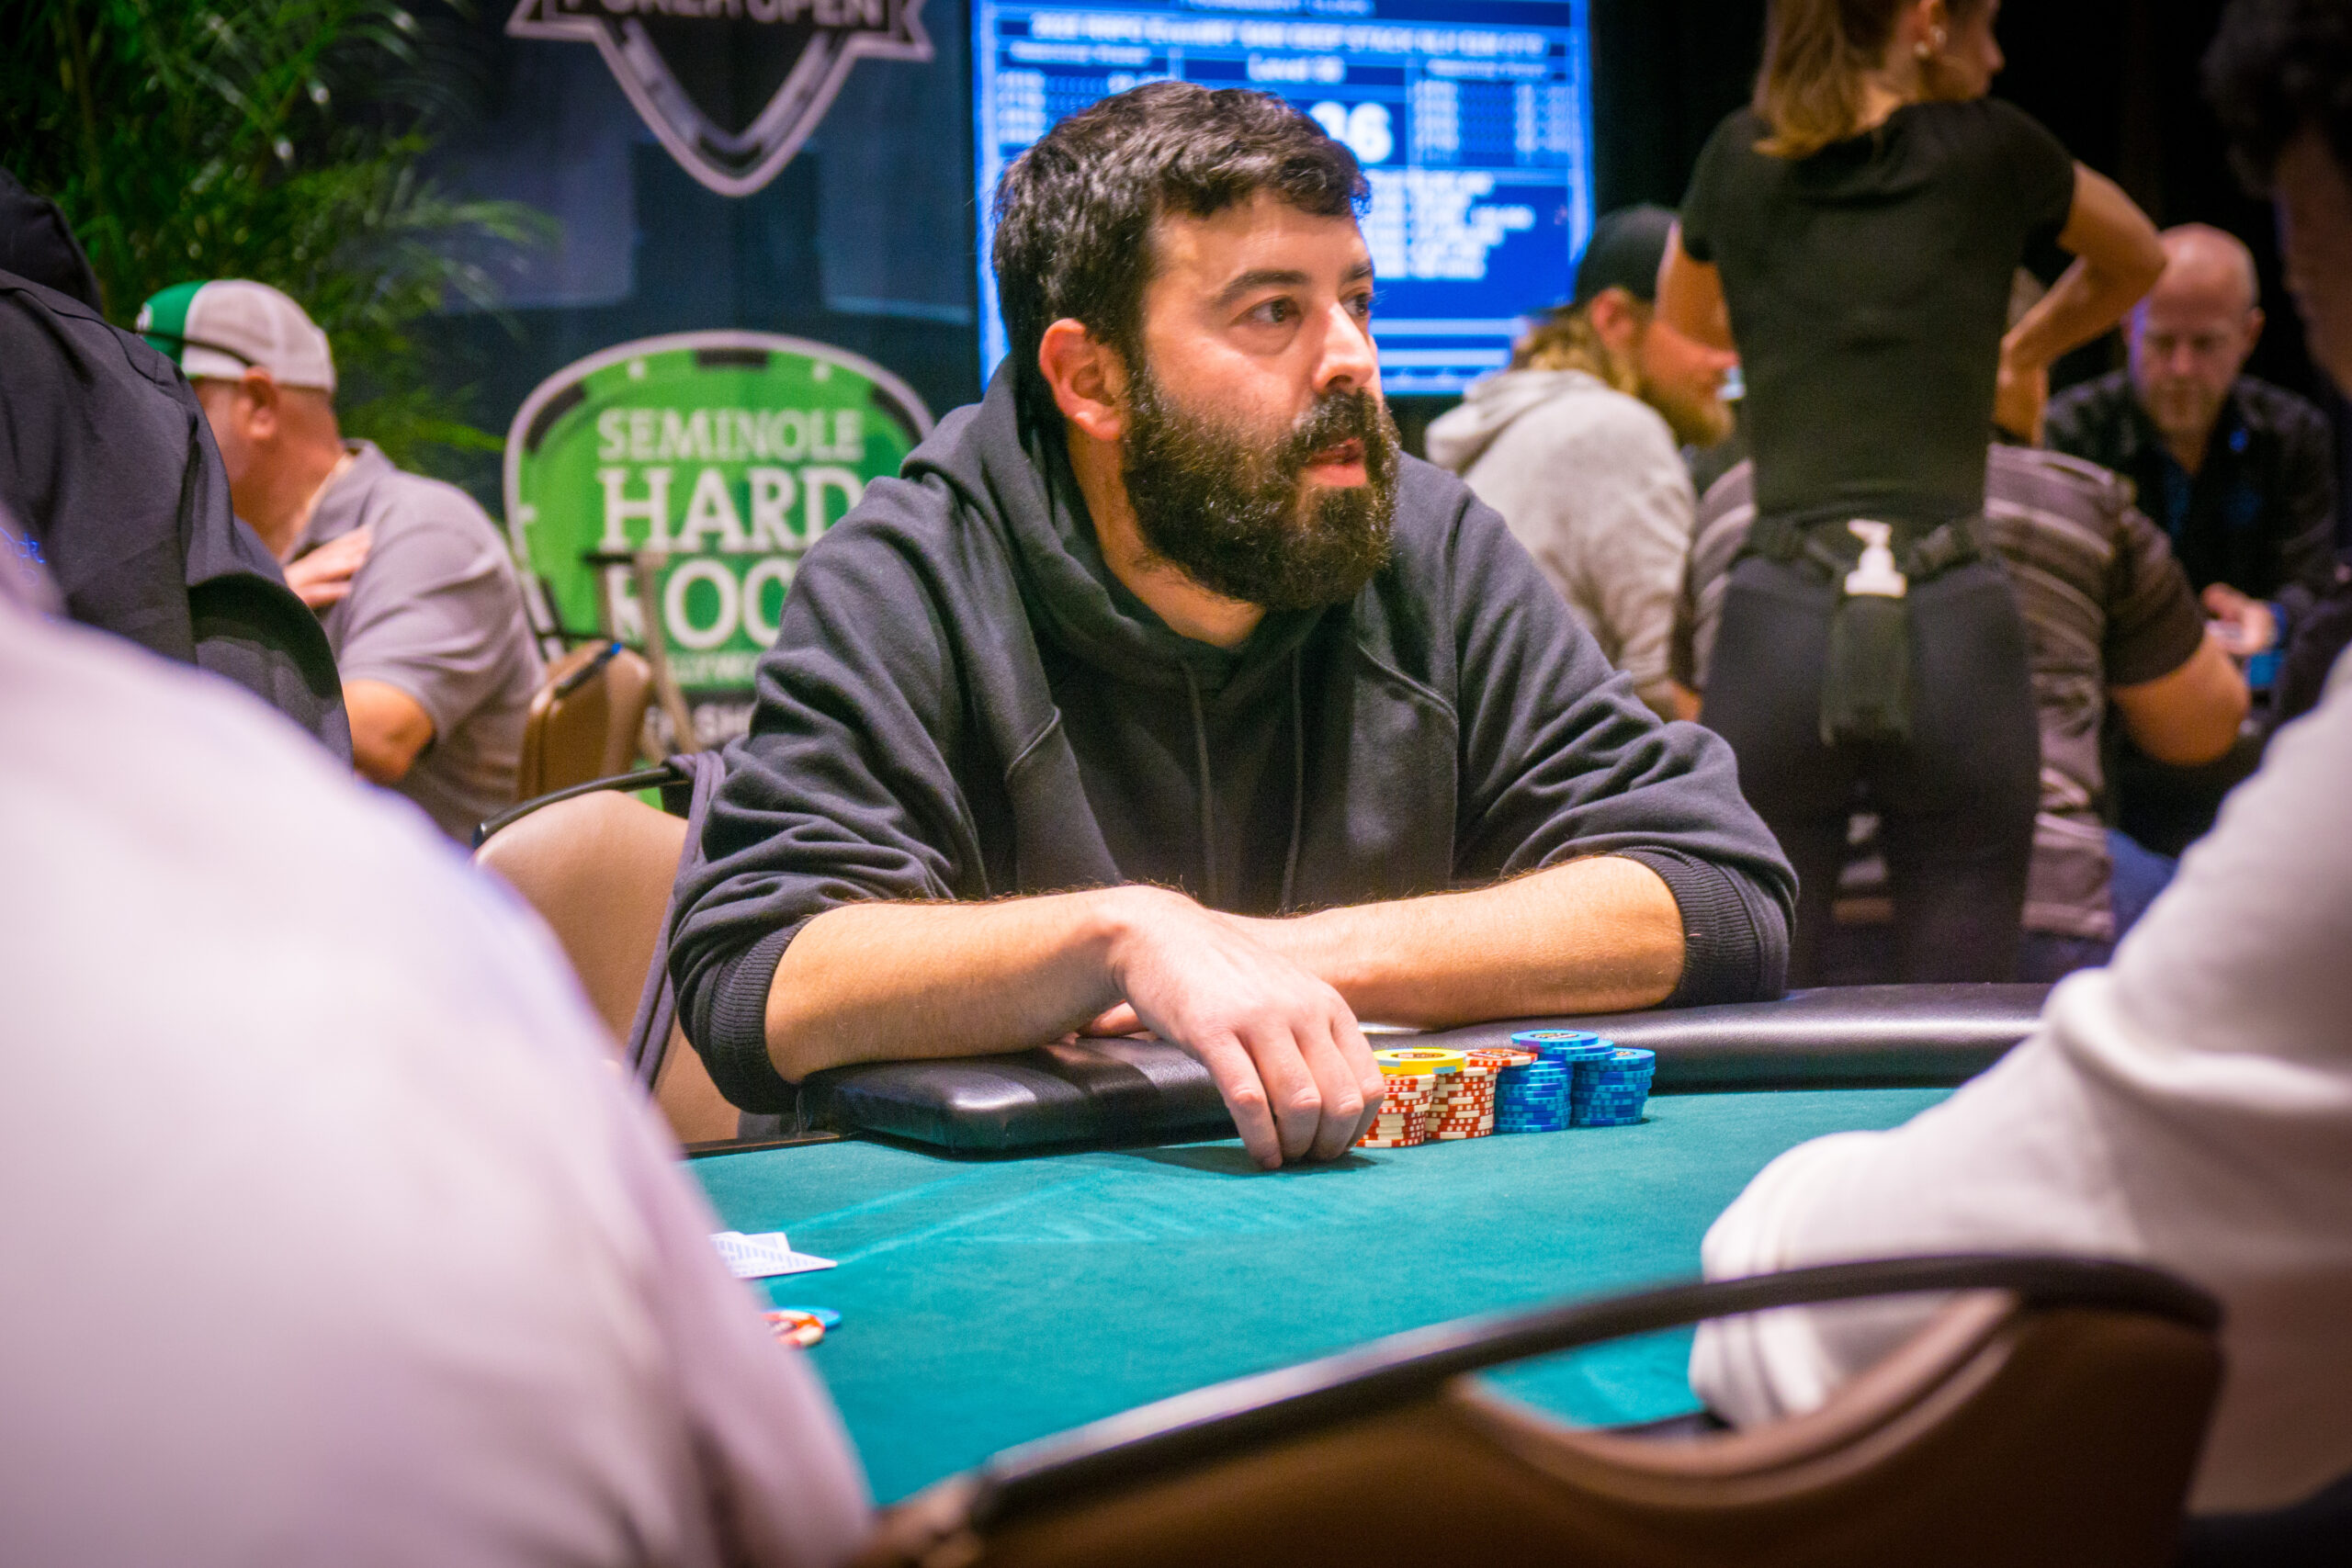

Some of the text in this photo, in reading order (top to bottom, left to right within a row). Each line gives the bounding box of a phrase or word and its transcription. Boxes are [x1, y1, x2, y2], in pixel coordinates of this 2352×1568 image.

[597, 409, 864, 461] SEMINOLE
[598, 466, 866, 551] HARD
[606, 558, 797, 647] ROC
